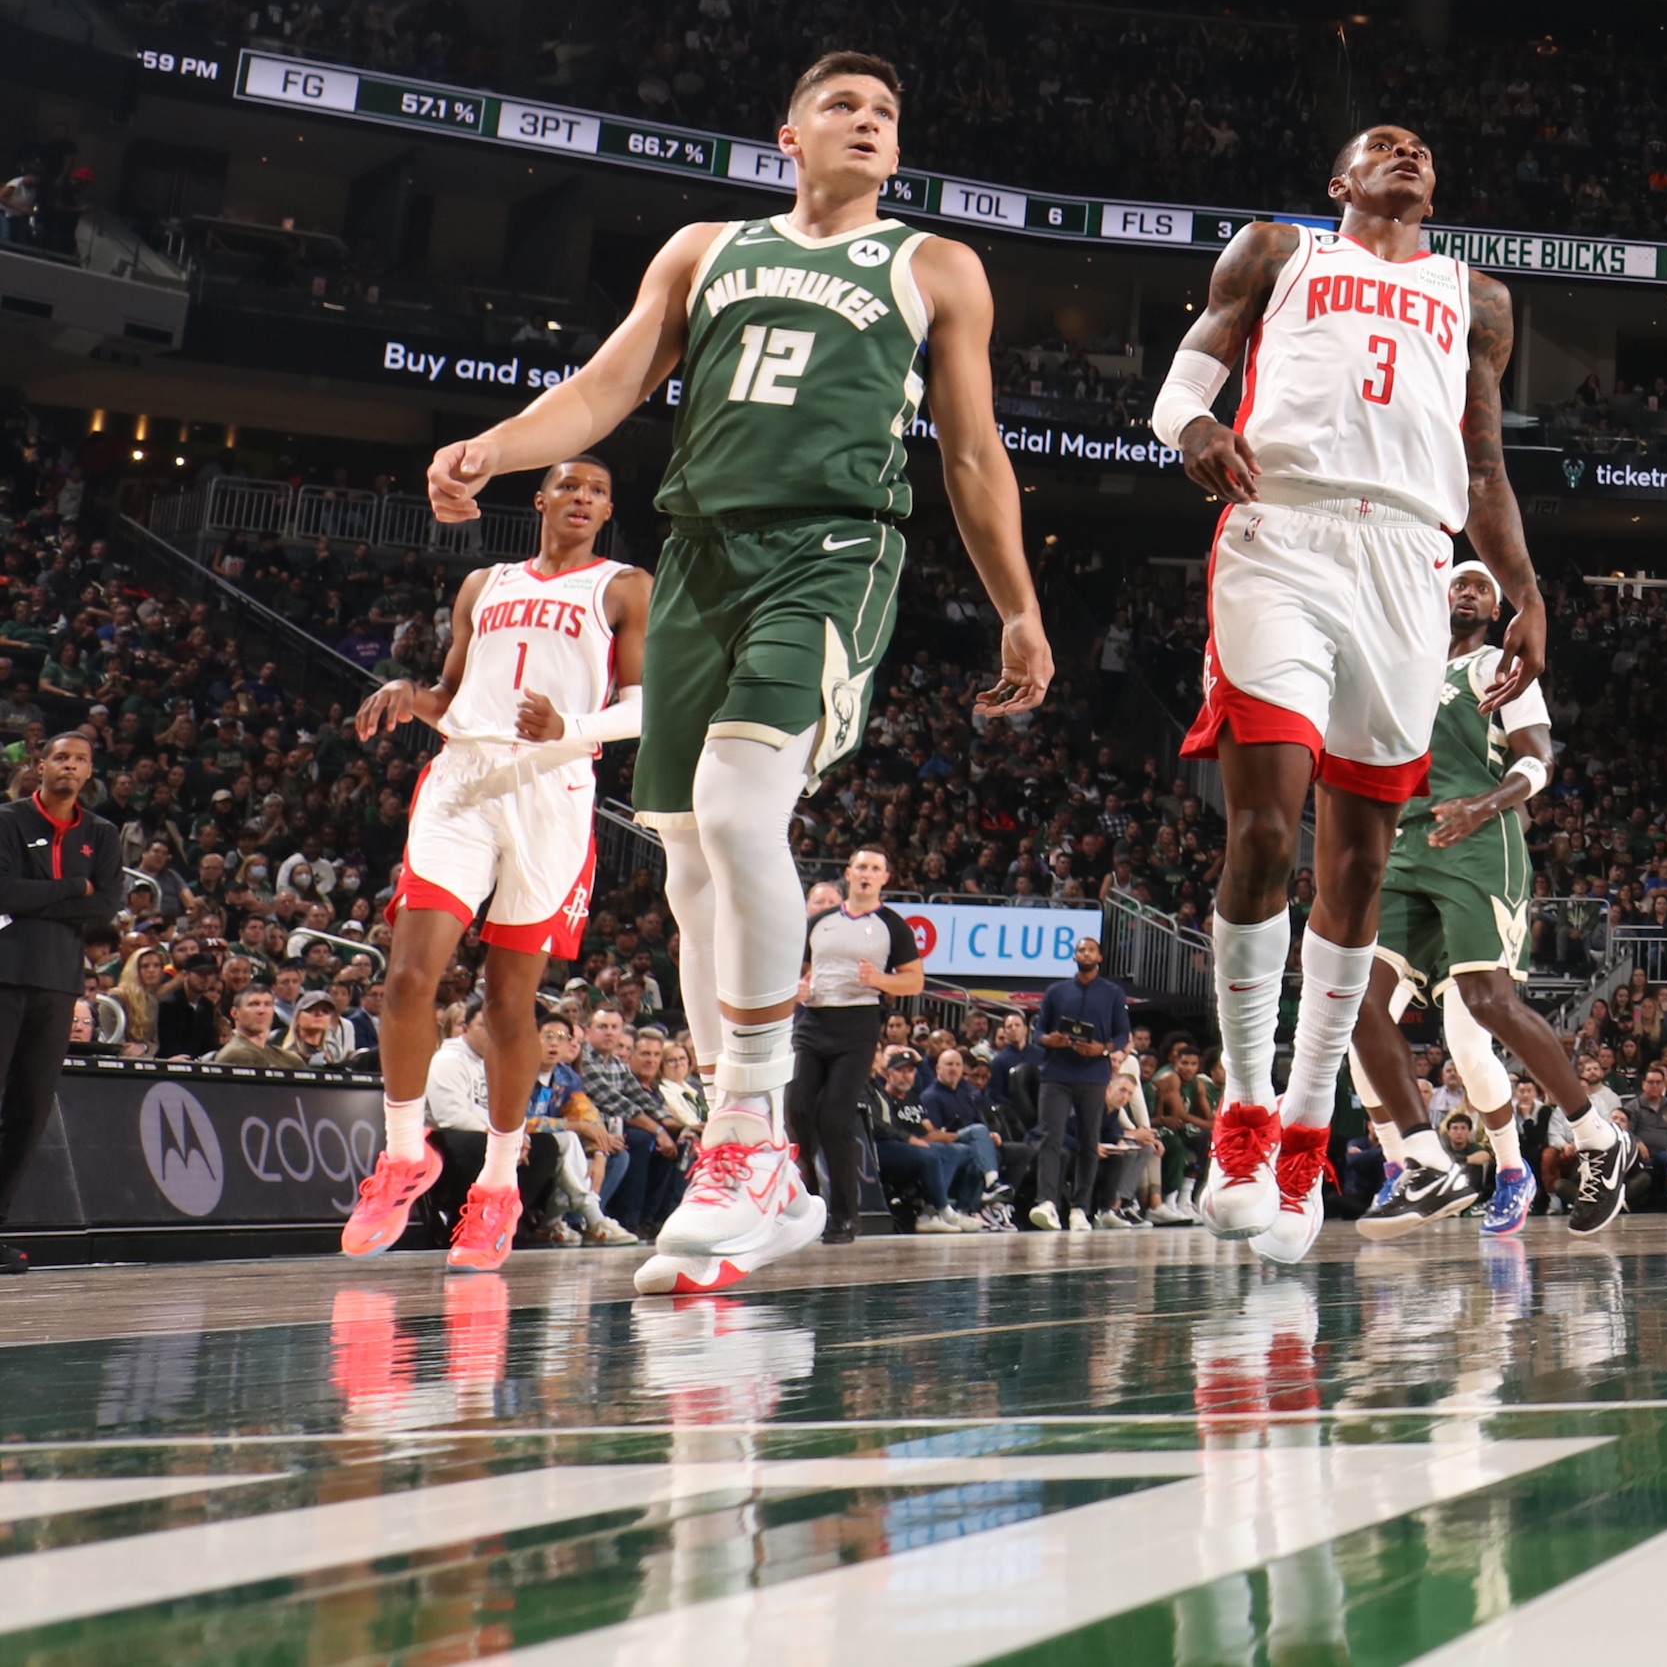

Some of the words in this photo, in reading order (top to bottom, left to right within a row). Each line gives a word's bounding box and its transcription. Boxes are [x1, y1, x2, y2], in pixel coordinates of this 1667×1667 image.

[181, 57, 219, 80] PM
[281, 69, 325, 100] FG
[401, 92, 448, 120] 57.1
[454, 102, 475, 125] %
[520, 111, 582, 144] 3PT
[628, 132, 680, 159] 66.7
[685, 143, 705, 165] %
[755, 154, 793, 181] FT
[894, 182, 912, 202] %
[960, 188, 1010, 220] TOL
[1047, 205, 1063, 227] 6
[1123, 211, 1174, 237] FLS
[1217, 219, 1233, 240] 3
[1429, 229, 1533, 266] WAUKEE
[1541, 242, 1626, 274] BUCKS
[704, 266, 890, 331] MILWAUKEE
[1306, 274, 1458, 355] ROCKETS
[384, 341, 446, 381] Buy
[455, 358, 519, 386] and
[728, 324, 816, 406] 12
[1362, 334, 1397, 405] 3
[478, 598, 586, 640] ROCKETS
[513, 642, 528, 690] 1
[968, 923, 1075, 961] CLUB
[241, 1097, 376, 1215] edge
